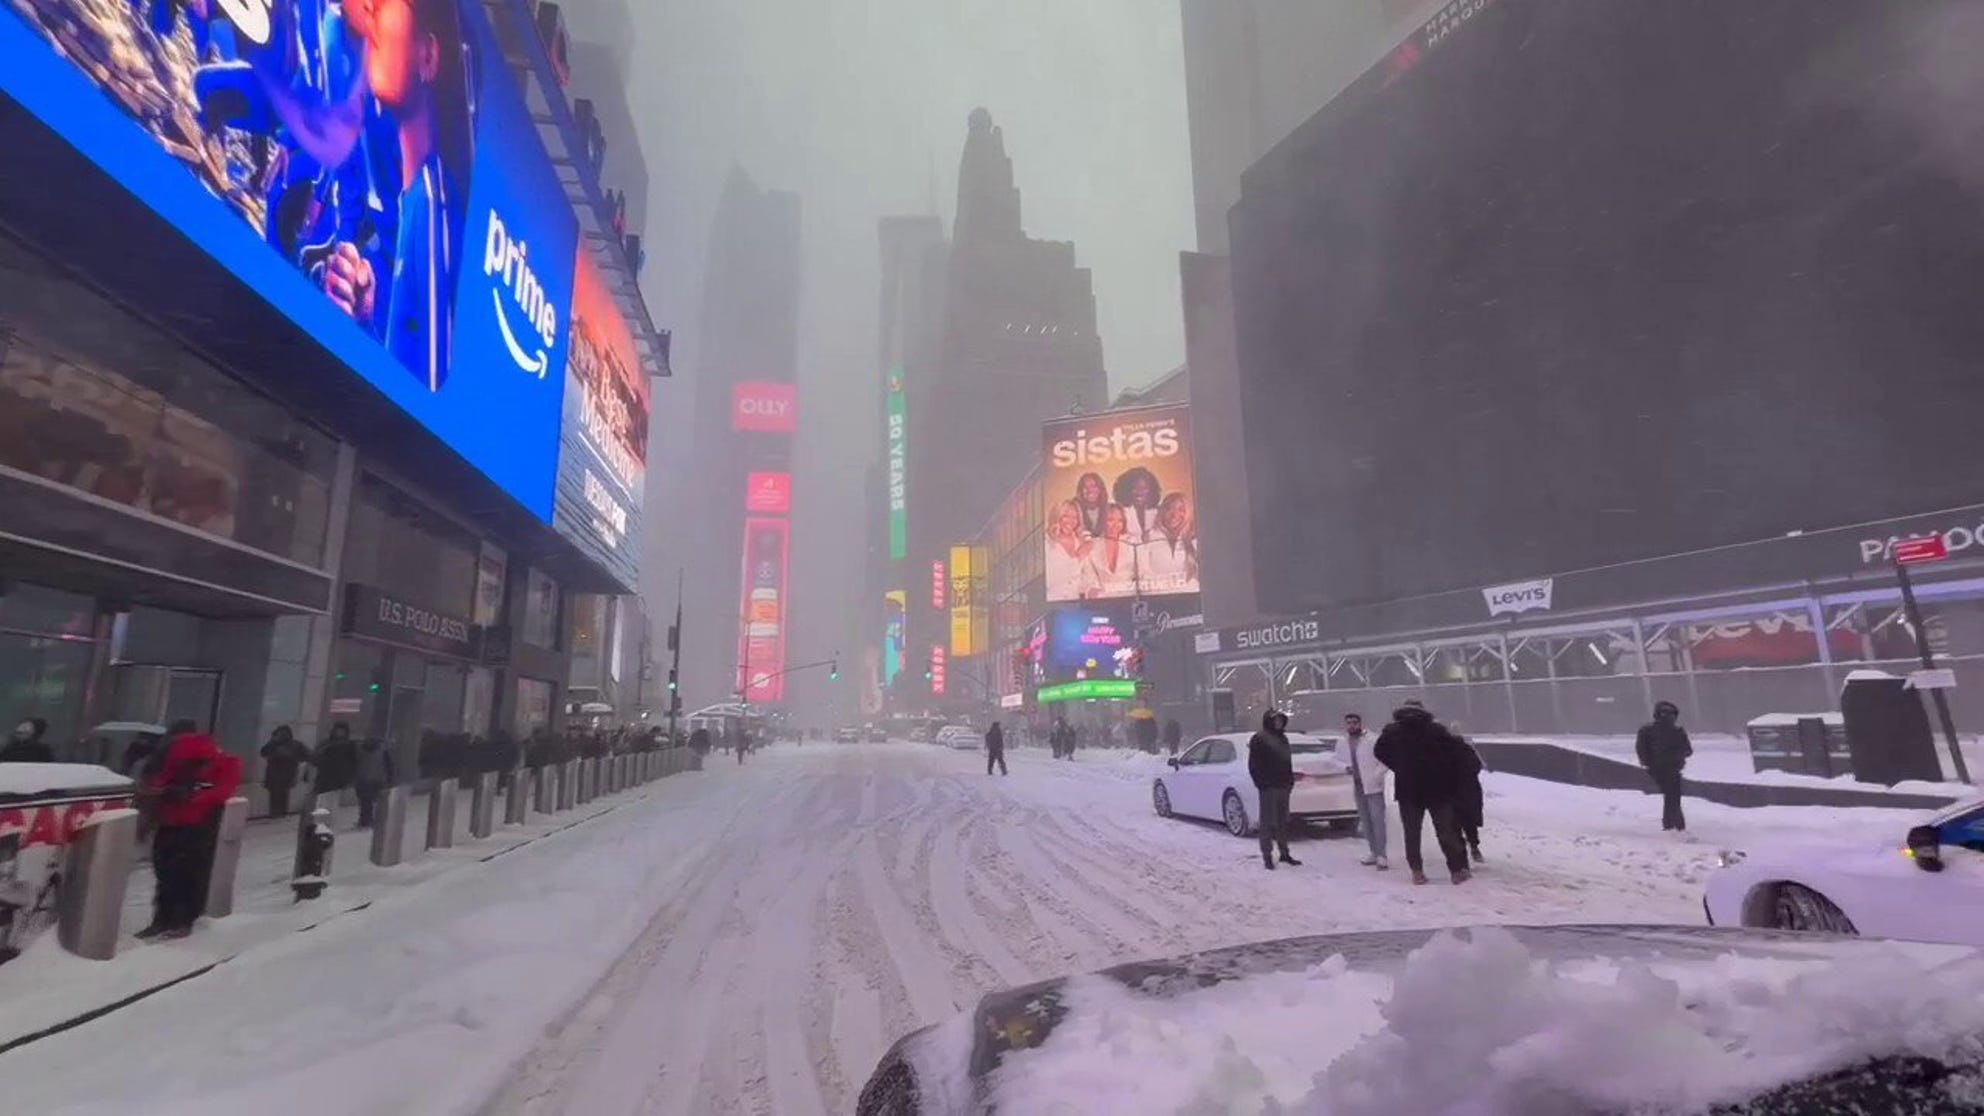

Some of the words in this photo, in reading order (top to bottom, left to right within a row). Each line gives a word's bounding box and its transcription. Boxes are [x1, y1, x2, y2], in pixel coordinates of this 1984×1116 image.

[484, 208, 556, 348] prime
[739, 398, 789, 416] OLLY
[1053, 427, 1179, 467] sistas
[890, 442, 905, 512] YEARS
[405, 606, 438, 634] POLO
[1236, 621, 1304, 648] swatch
